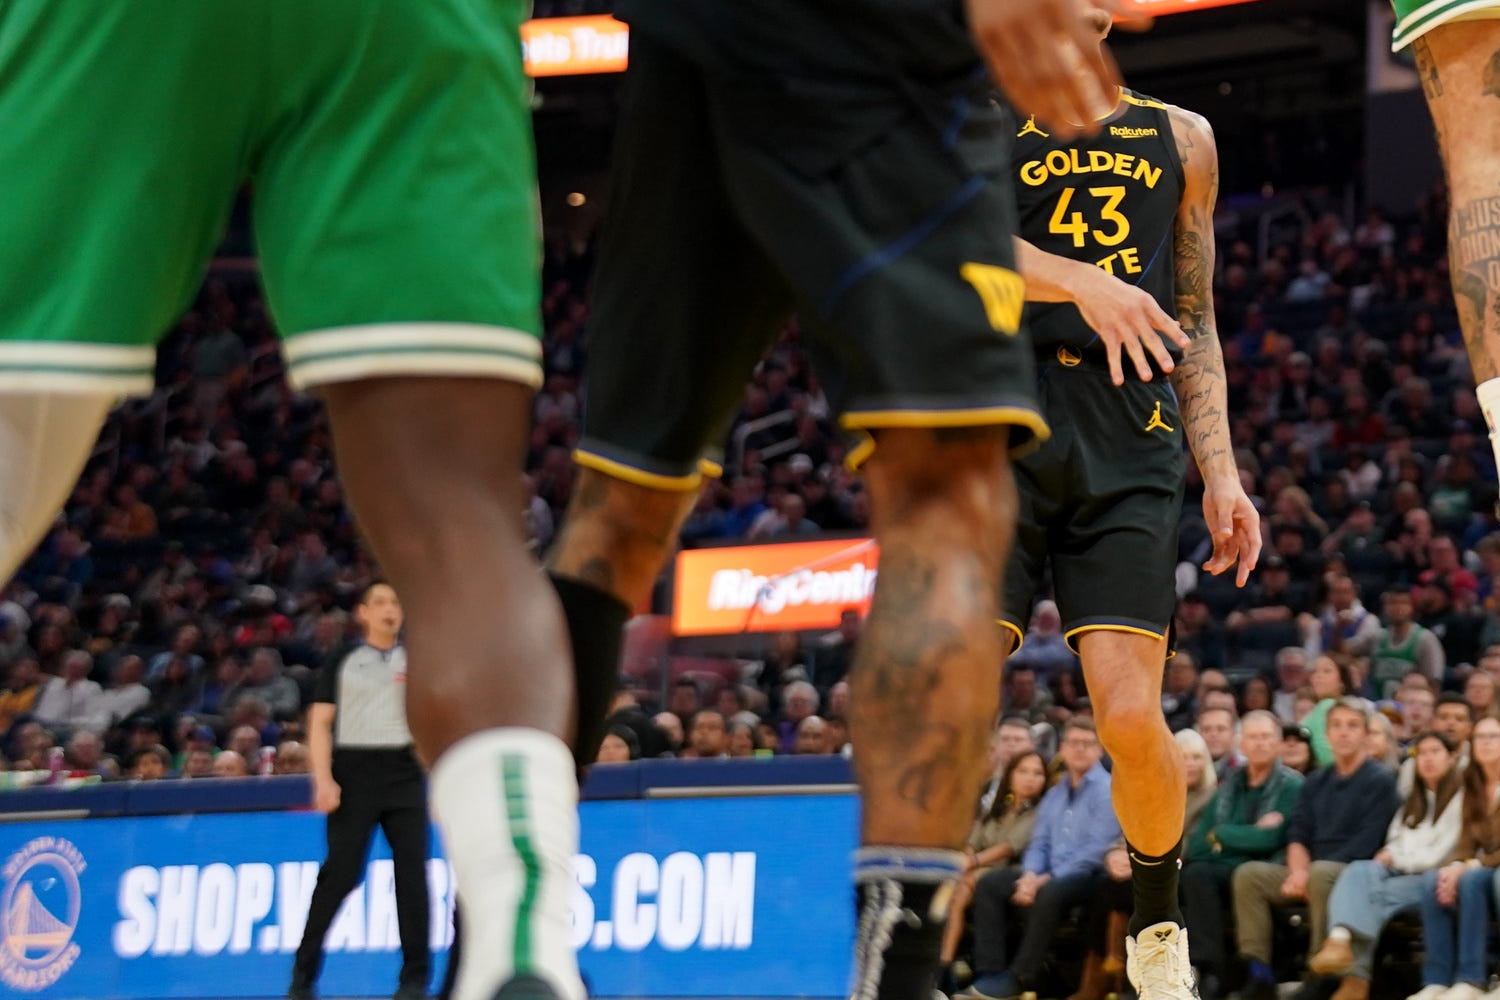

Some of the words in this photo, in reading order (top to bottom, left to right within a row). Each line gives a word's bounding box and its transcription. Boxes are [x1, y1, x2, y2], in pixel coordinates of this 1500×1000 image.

[1110, 126, 1158, 139] Rakuten
[1020, 148, 1163, 189] GOLDEN
[1049, 186, 1130, 248] 43
